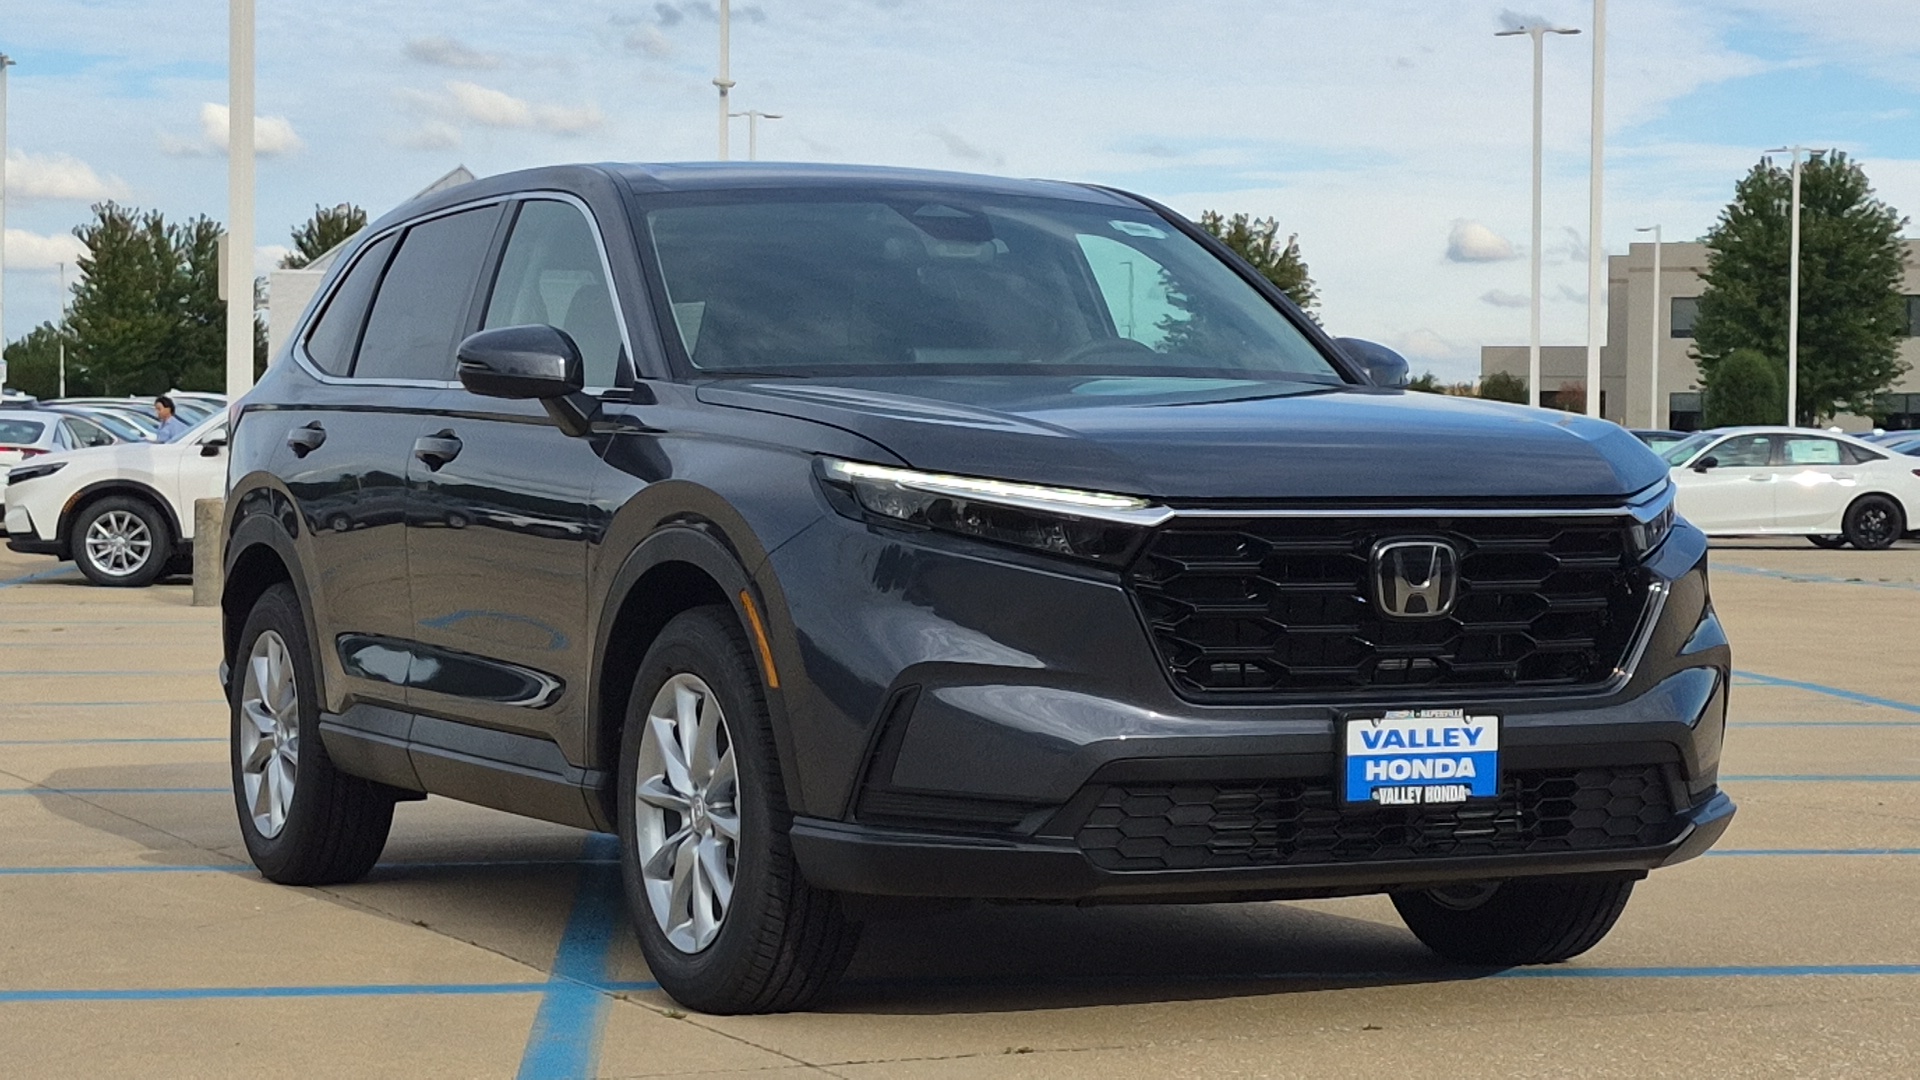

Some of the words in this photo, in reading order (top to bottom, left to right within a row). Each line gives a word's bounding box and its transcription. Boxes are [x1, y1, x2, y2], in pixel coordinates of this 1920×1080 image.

[1360, 727, 1484, 750] VALLEY
[1365, 757, 1476, 781] HONDA
[1379, 786, 1423, 805] VALLEY
[1425, 784, 1467, 803] HONDA
